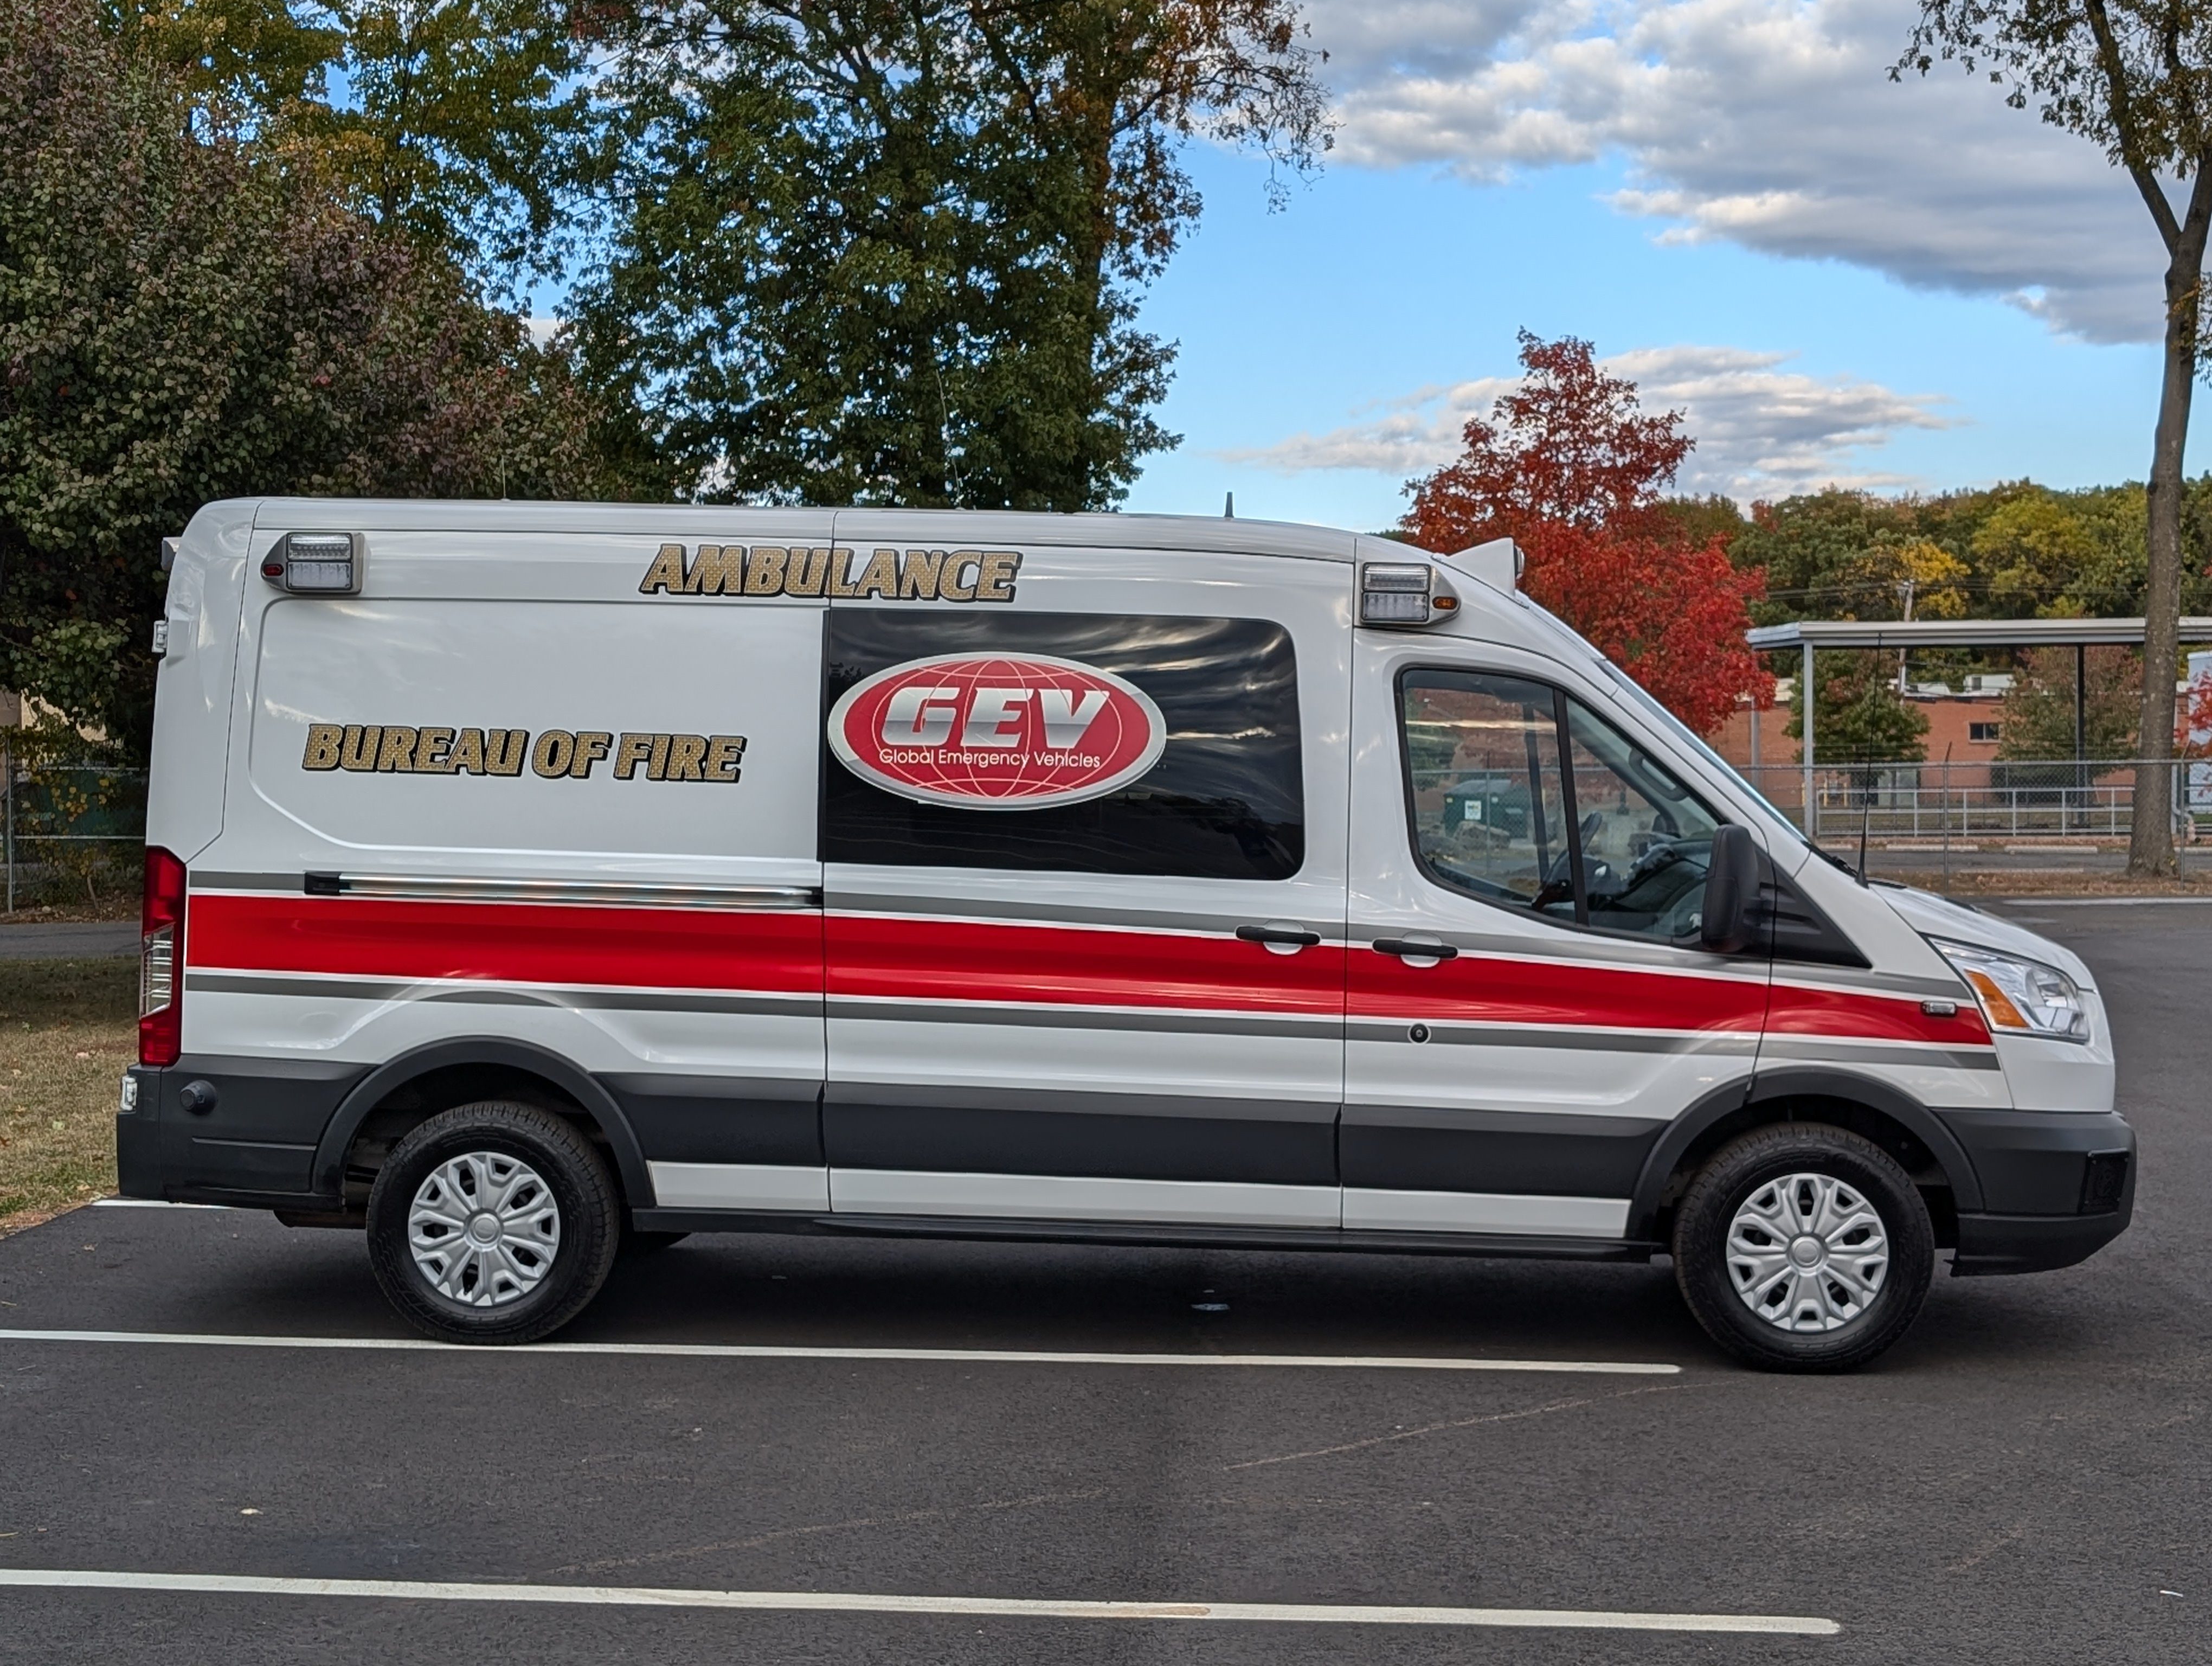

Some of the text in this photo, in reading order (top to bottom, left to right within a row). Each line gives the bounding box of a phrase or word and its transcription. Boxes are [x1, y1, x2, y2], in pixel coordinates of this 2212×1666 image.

[638, 543, 1022, 603] AMBULANCE
[881, 686, 1110, 748] GEV
[302, 723, 747, 784] BUREAU OF FIRE
[879, 748, 1100, 768] Global Emergency Vehicles
